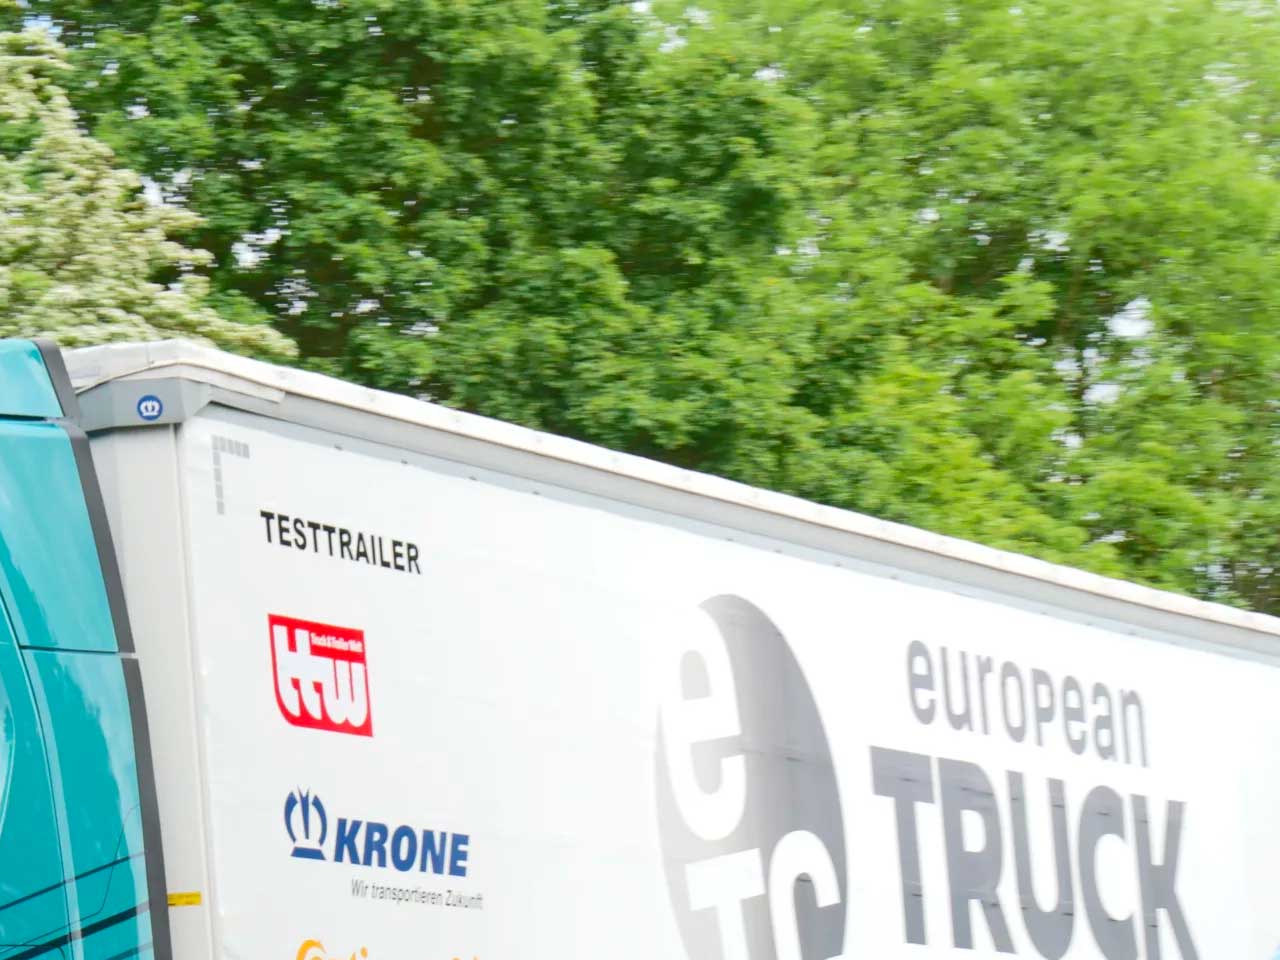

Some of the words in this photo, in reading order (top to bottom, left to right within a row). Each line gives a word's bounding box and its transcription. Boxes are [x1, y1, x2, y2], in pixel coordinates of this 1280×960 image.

[260, 510, 421, 575] TESTTRAILER
[334, 817, 470, 877] KRONE
[351, 878, 369, 897] Wir
